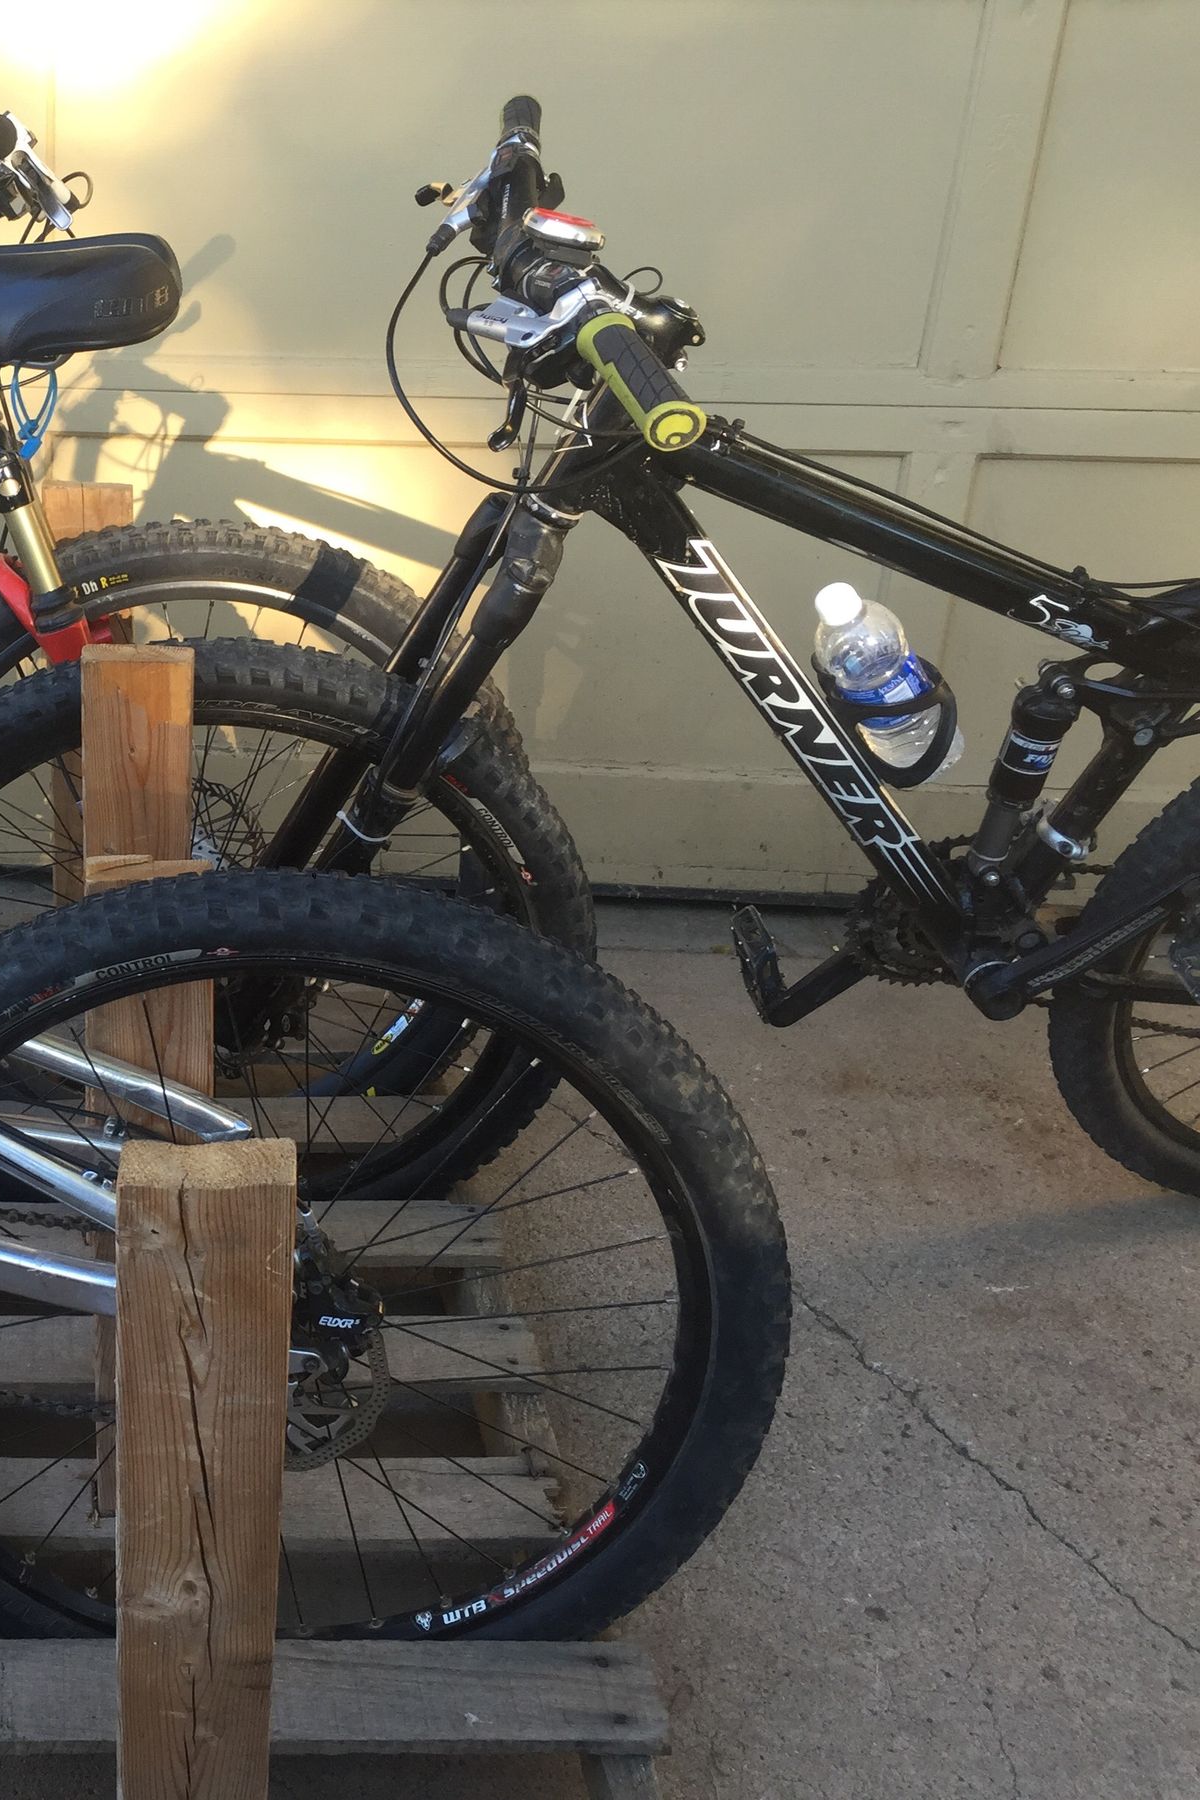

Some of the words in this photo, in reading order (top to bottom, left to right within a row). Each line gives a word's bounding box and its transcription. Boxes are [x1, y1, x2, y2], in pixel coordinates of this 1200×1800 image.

[99, 576, 109, 589] R
[653, 539, 912, 848] TURNER
[95, 954, 173, 981] CONTROL
[442, 1599, 487, 1625] WTB
[586, 1509, 613, 1535] TRAIL
